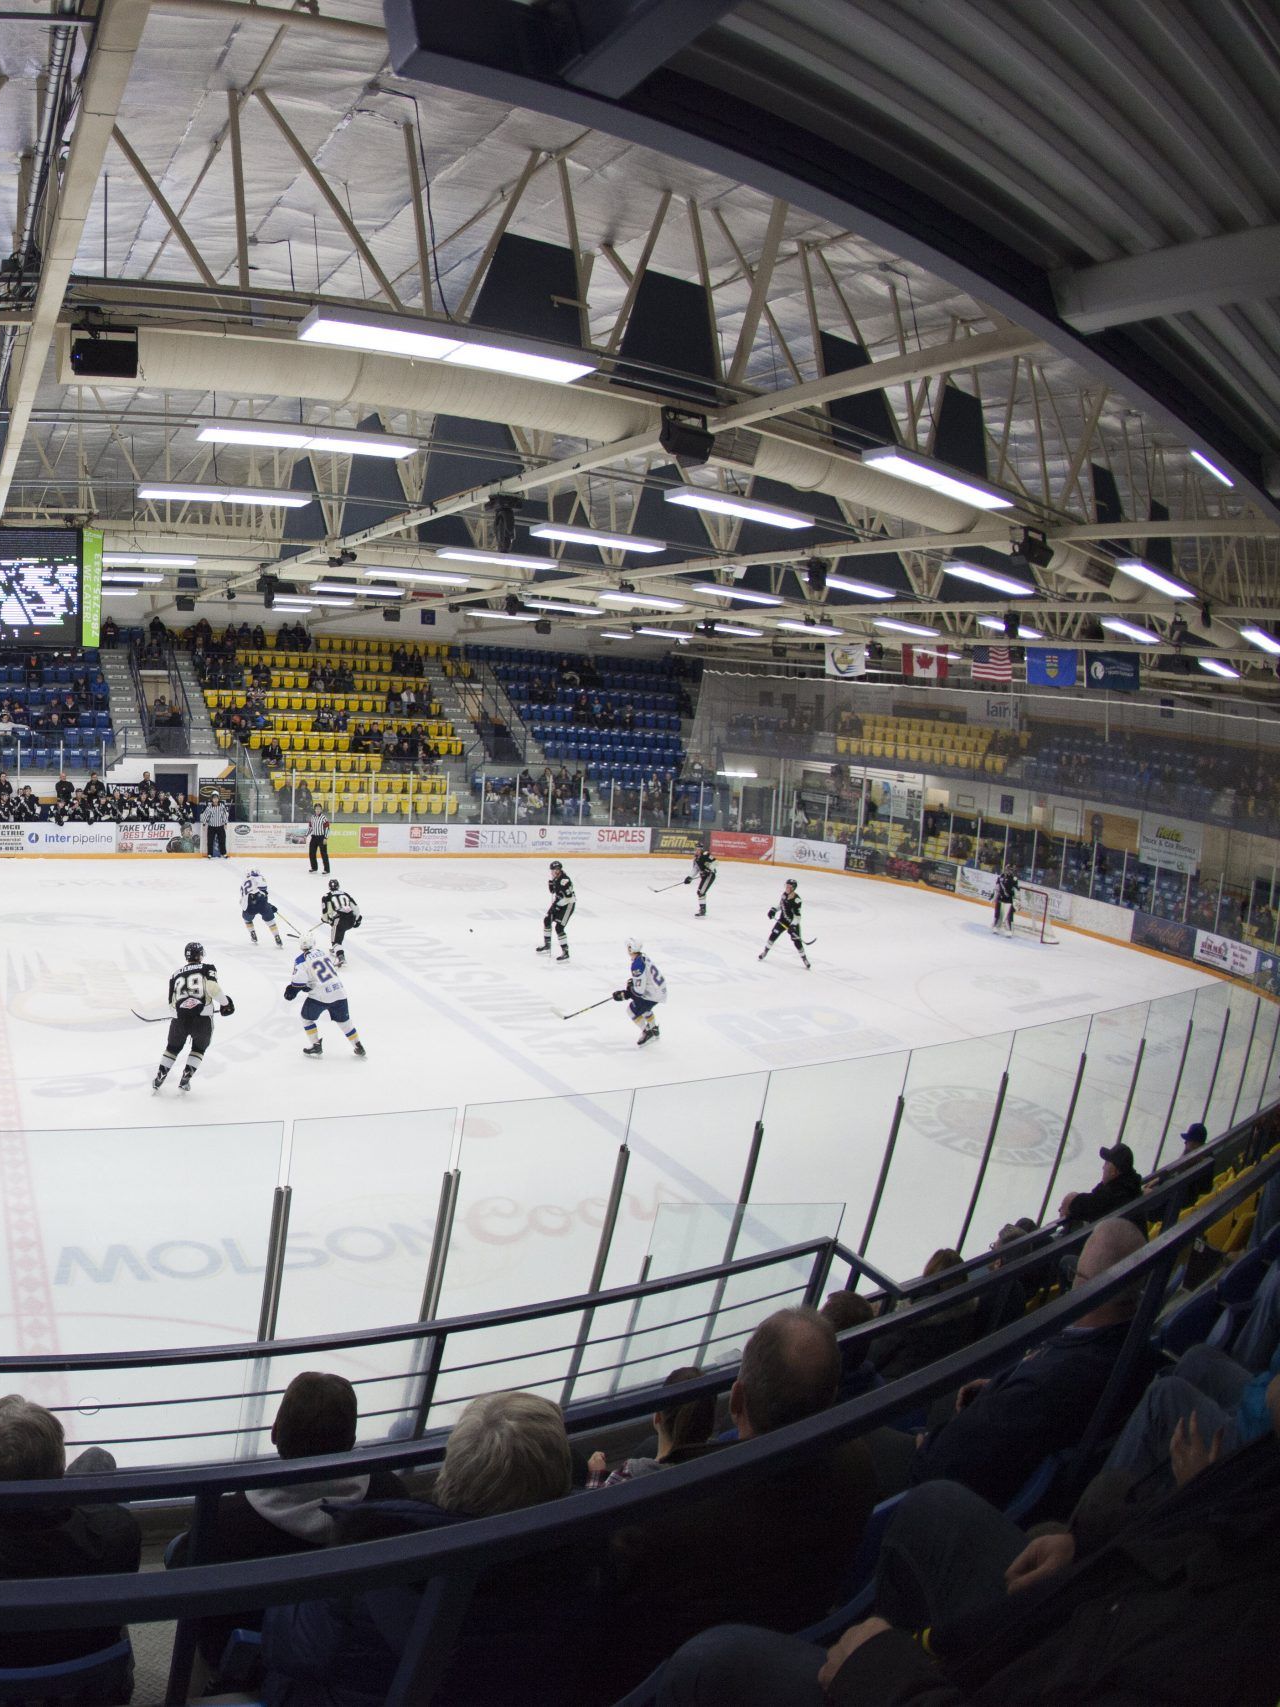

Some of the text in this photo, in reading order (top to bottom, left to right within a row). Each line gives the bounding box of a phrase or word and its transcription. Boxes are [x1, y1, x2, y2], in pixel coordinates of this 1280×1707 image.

[986, 700, 1019, 719] laird
[123, 830, 173, 839] BEST SHOT!
[142, 824, 166, 832] YOUR
[423, 826, 448, 835] Home
[480, 830, 528, 844] STRAD
[597, 829, 645, 842] STAPLES
[174, 973, 204, 998] 29
[53, 1216, 463, 1288] MOLSON
